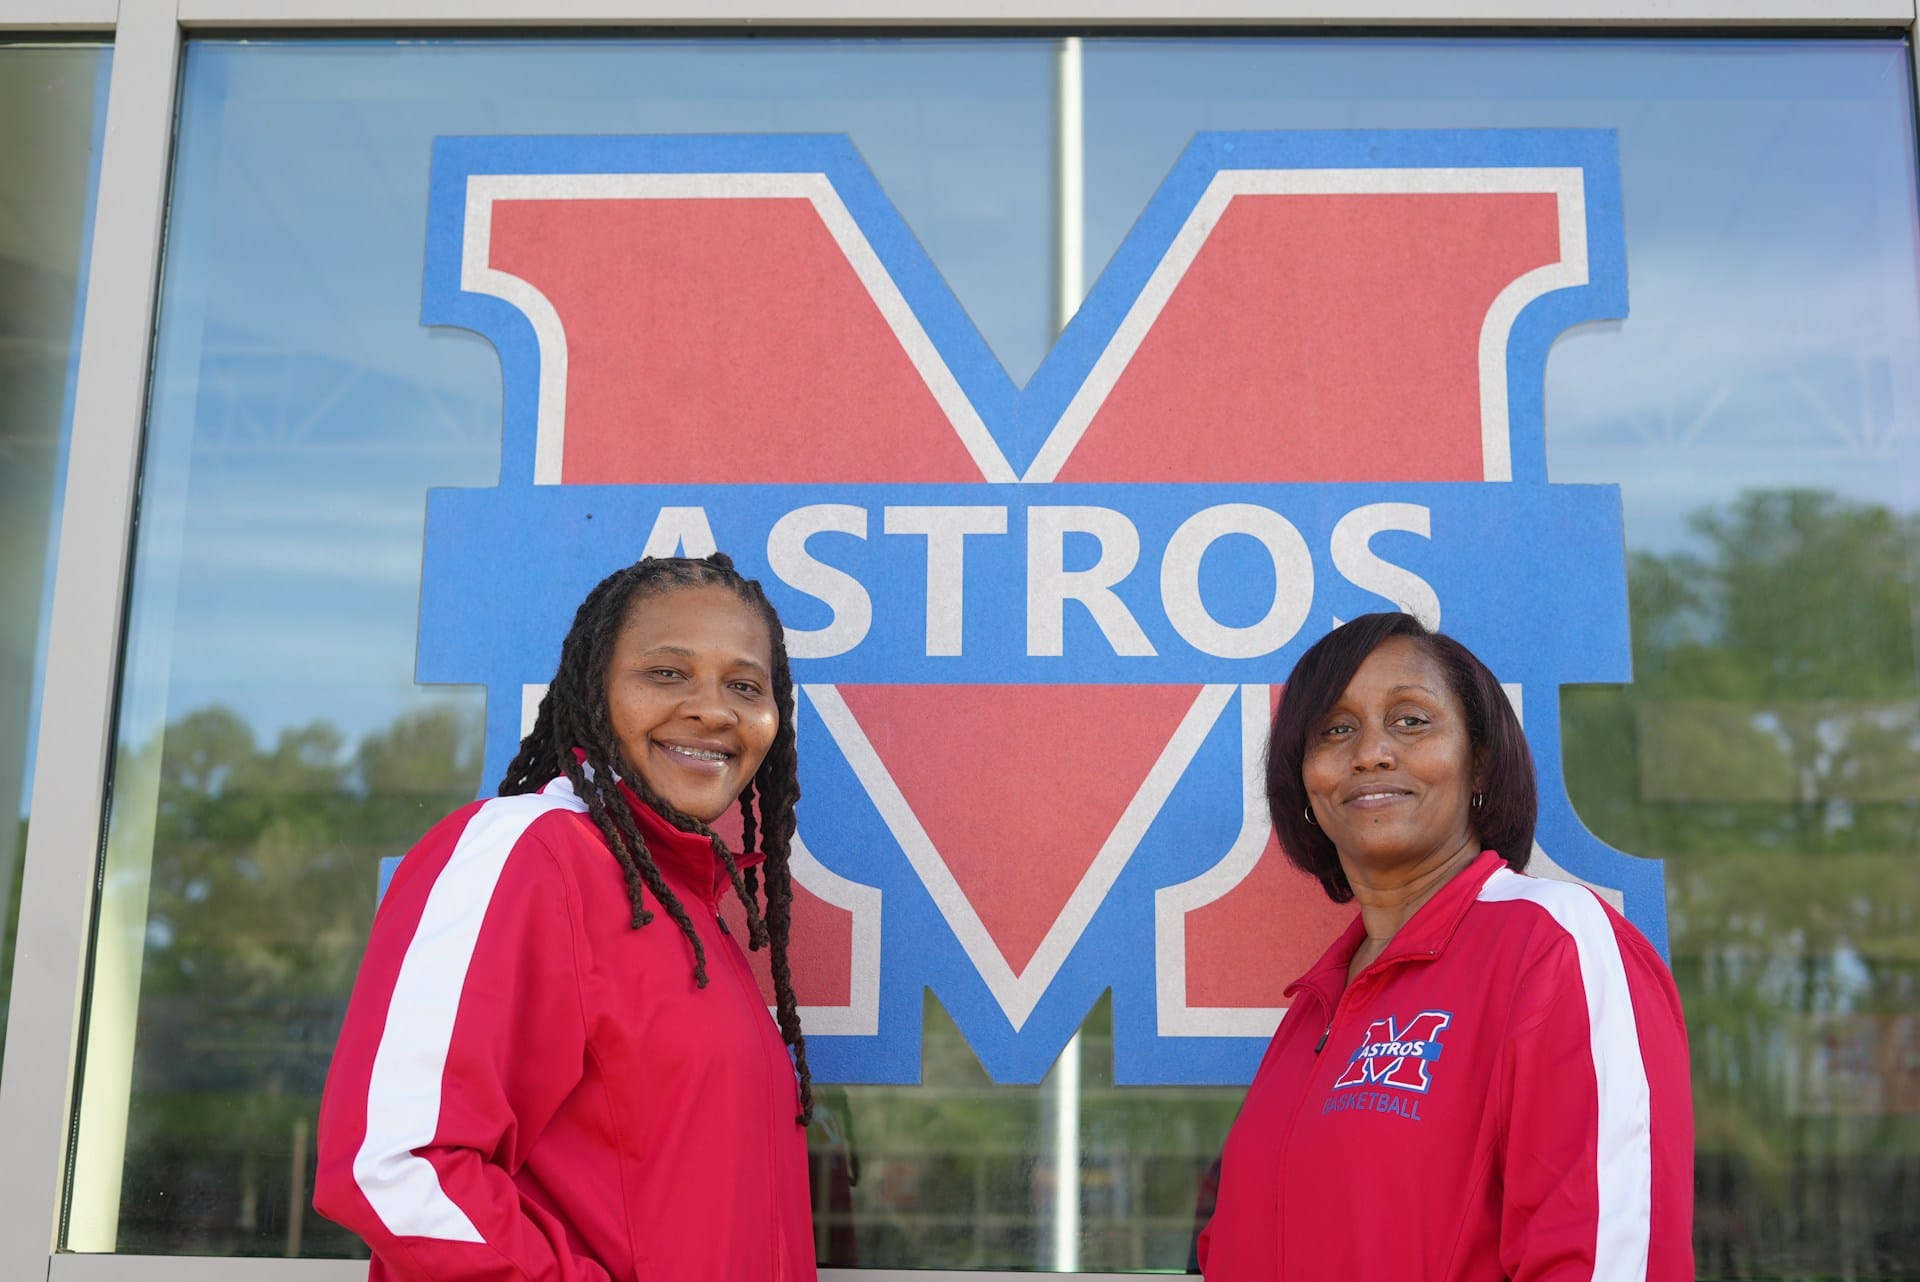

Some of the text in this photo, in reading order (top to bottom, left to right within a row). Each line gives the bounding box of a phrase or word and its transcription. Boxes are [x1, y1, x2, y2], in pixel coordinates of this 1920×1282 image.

[415, 129, 1664, 1087] M
[1332, 1009, 1453, 1094] M
[1358, 1041, 1425, 1059] ASTROS
[1322, 1092, 1421, 1120] BASKETBALL
